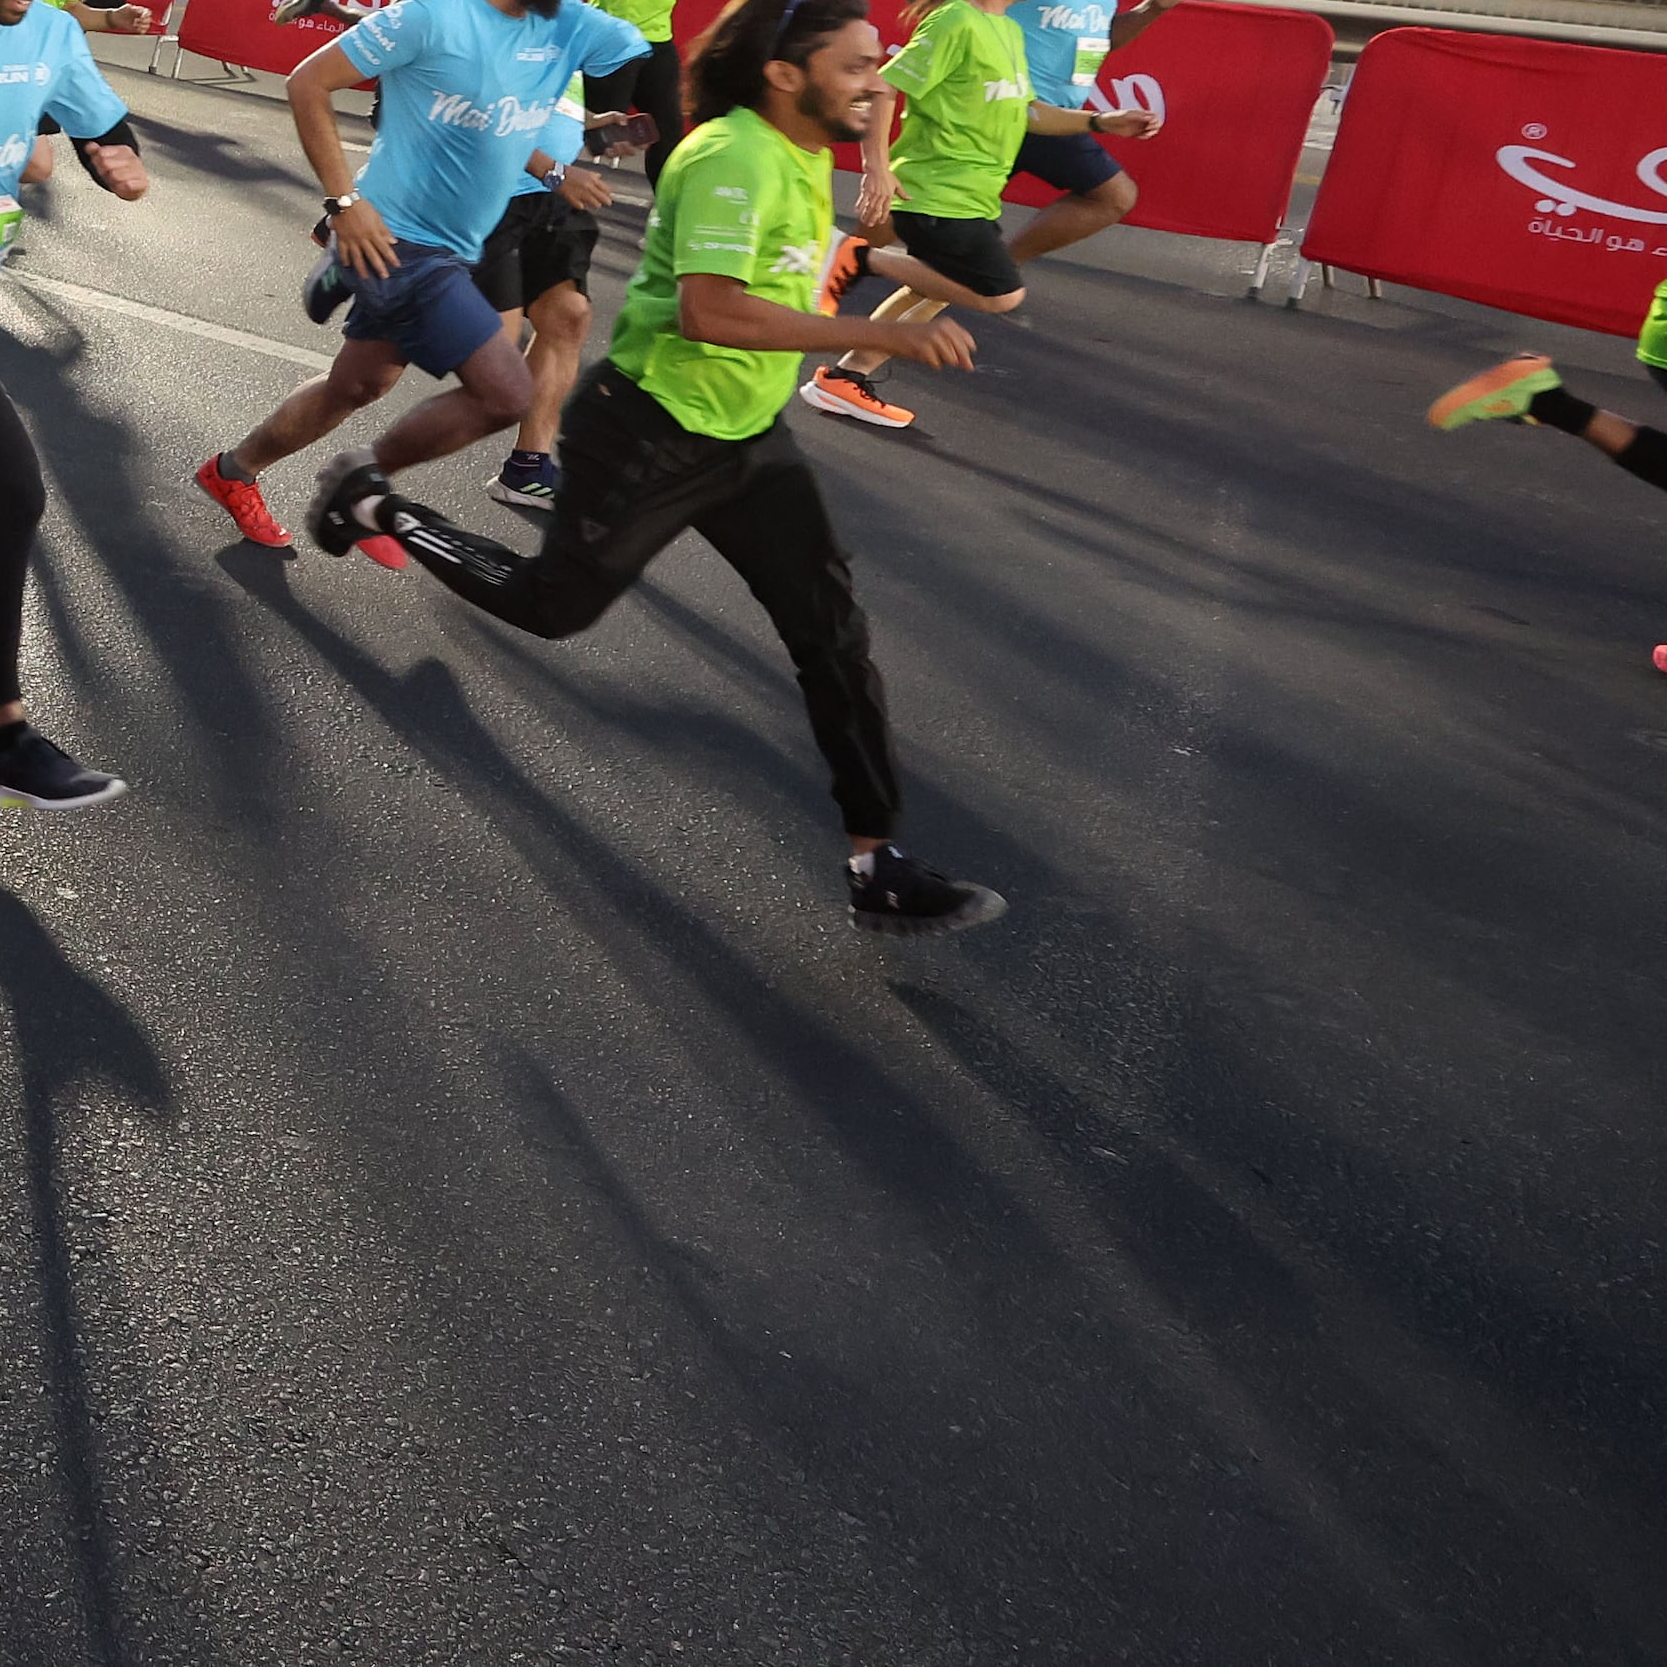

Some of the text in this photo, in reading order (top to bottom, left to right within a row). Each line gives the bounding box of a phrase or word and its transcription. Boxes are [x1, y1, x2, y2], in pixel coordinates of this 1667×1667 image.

[1037, 6, 1085, 29] Mai
[428, 91, 556, 137] Mai Dubai
[1528, 216, 1645, 252] هو الحياة
